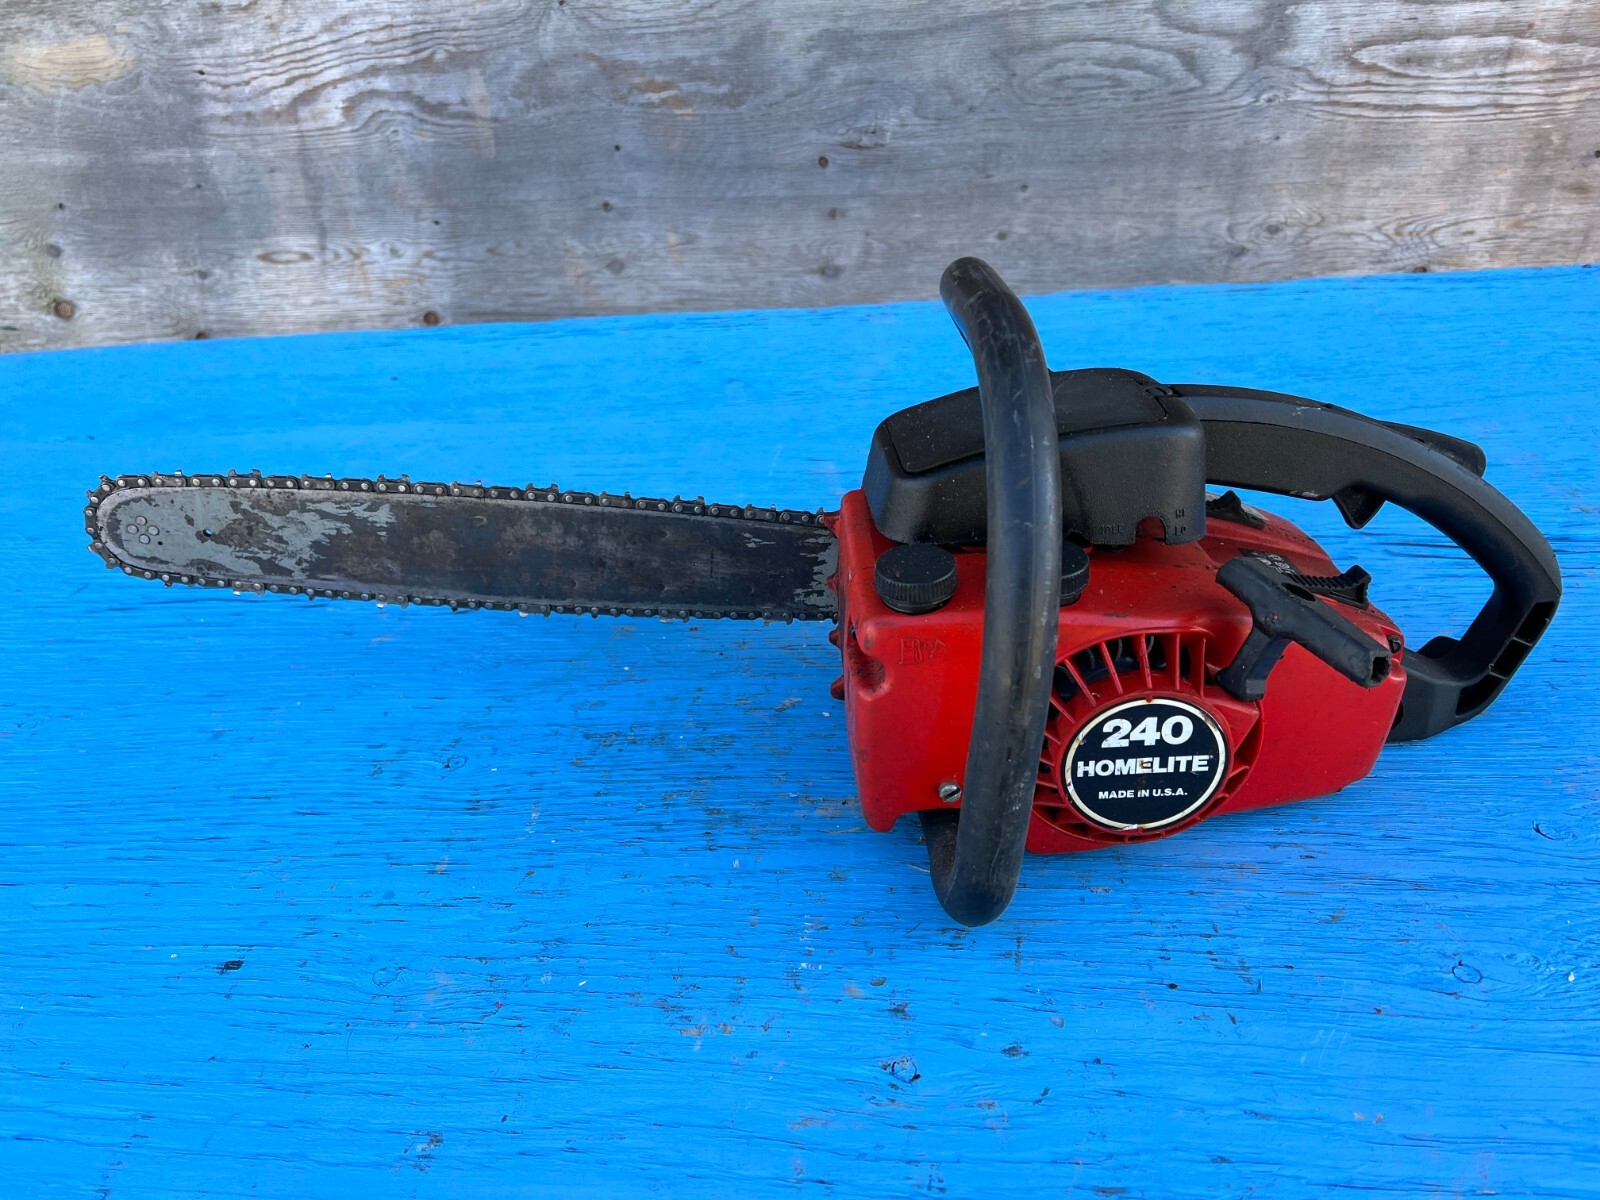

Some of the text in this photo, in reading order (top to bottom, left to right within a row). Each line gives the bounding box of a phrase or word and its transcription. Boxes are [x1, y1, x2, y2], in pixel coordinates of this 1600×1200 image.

[1101, 715, 1194, 748] 240
[1076, 755, 1210, 778] HOMELITE
[1098, 787, 1188, 799] MADE IN U.S.A.
